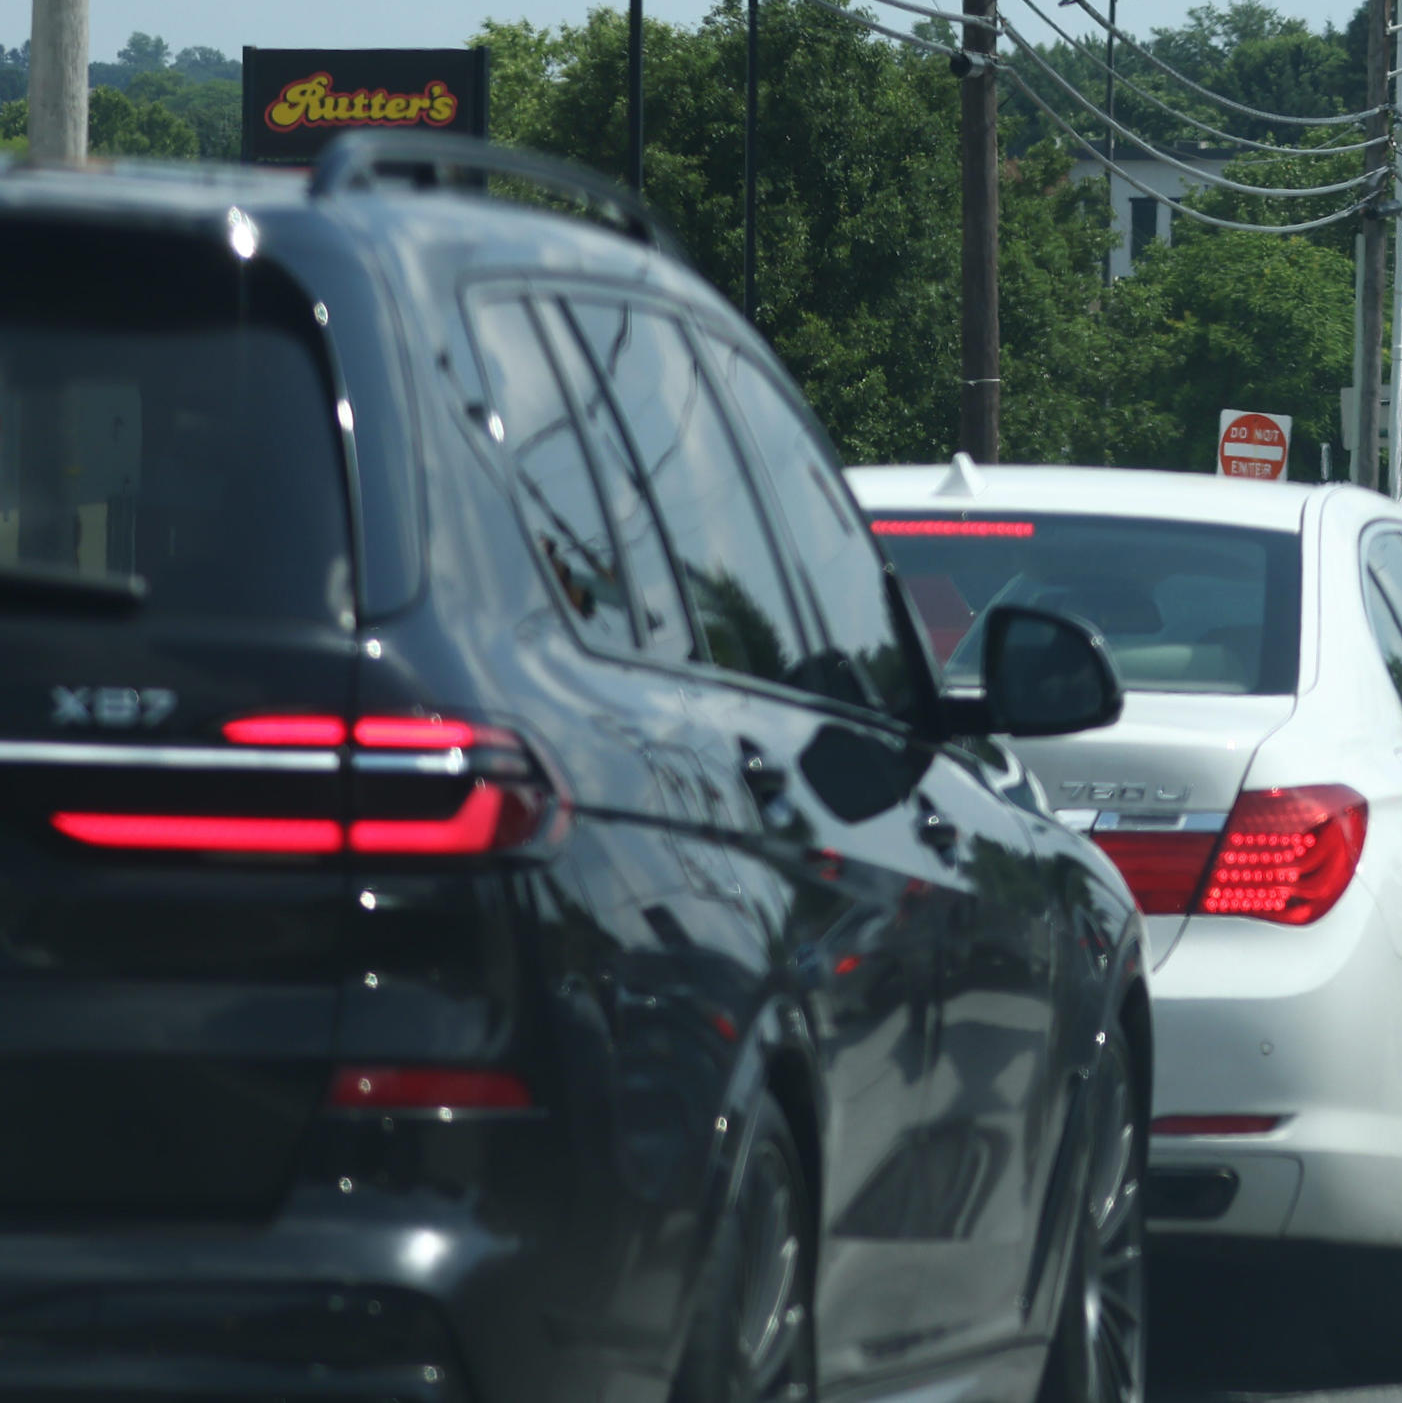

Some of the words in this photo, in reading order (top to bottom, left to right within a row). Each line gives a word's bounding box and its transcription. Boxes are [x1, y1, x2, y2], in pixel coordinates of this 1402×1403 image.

[271, 75, 454, 126] Rutter's
[1230, 427, 1248, 439] DO
[1254, 429, 1280, 442] NOT
[1231, 460, 1272, 477] ENTER
